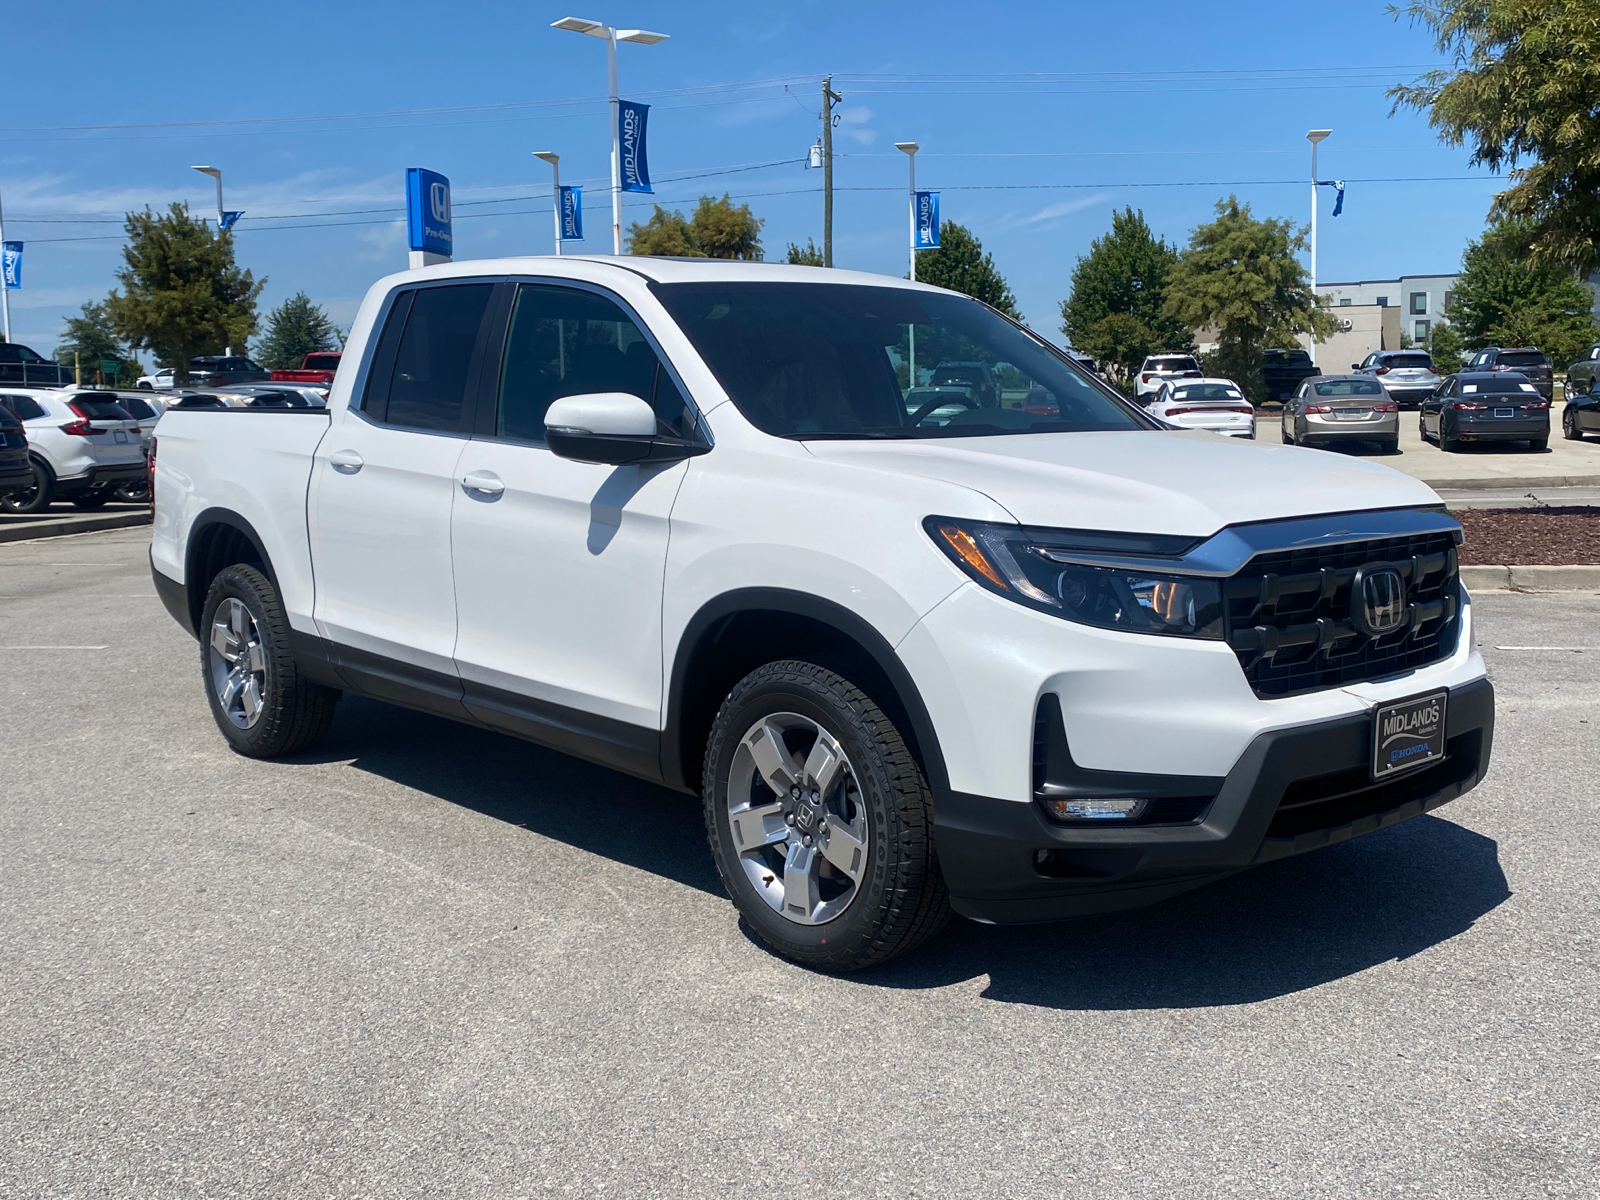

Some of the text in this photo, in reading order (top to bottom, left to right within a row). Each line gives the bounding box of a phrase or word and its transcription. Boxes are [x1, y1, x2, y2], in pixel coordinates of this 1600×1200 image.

[624, 109, 636, 184] MIDLANDS
[564, 190, 573, 236] MIDLANDS
[921, 196, 929, 244] MIDLANDS
[1384, 705, 1439, 736] MIDLANDS
[1399, 742, 1429, 757] HONDA
